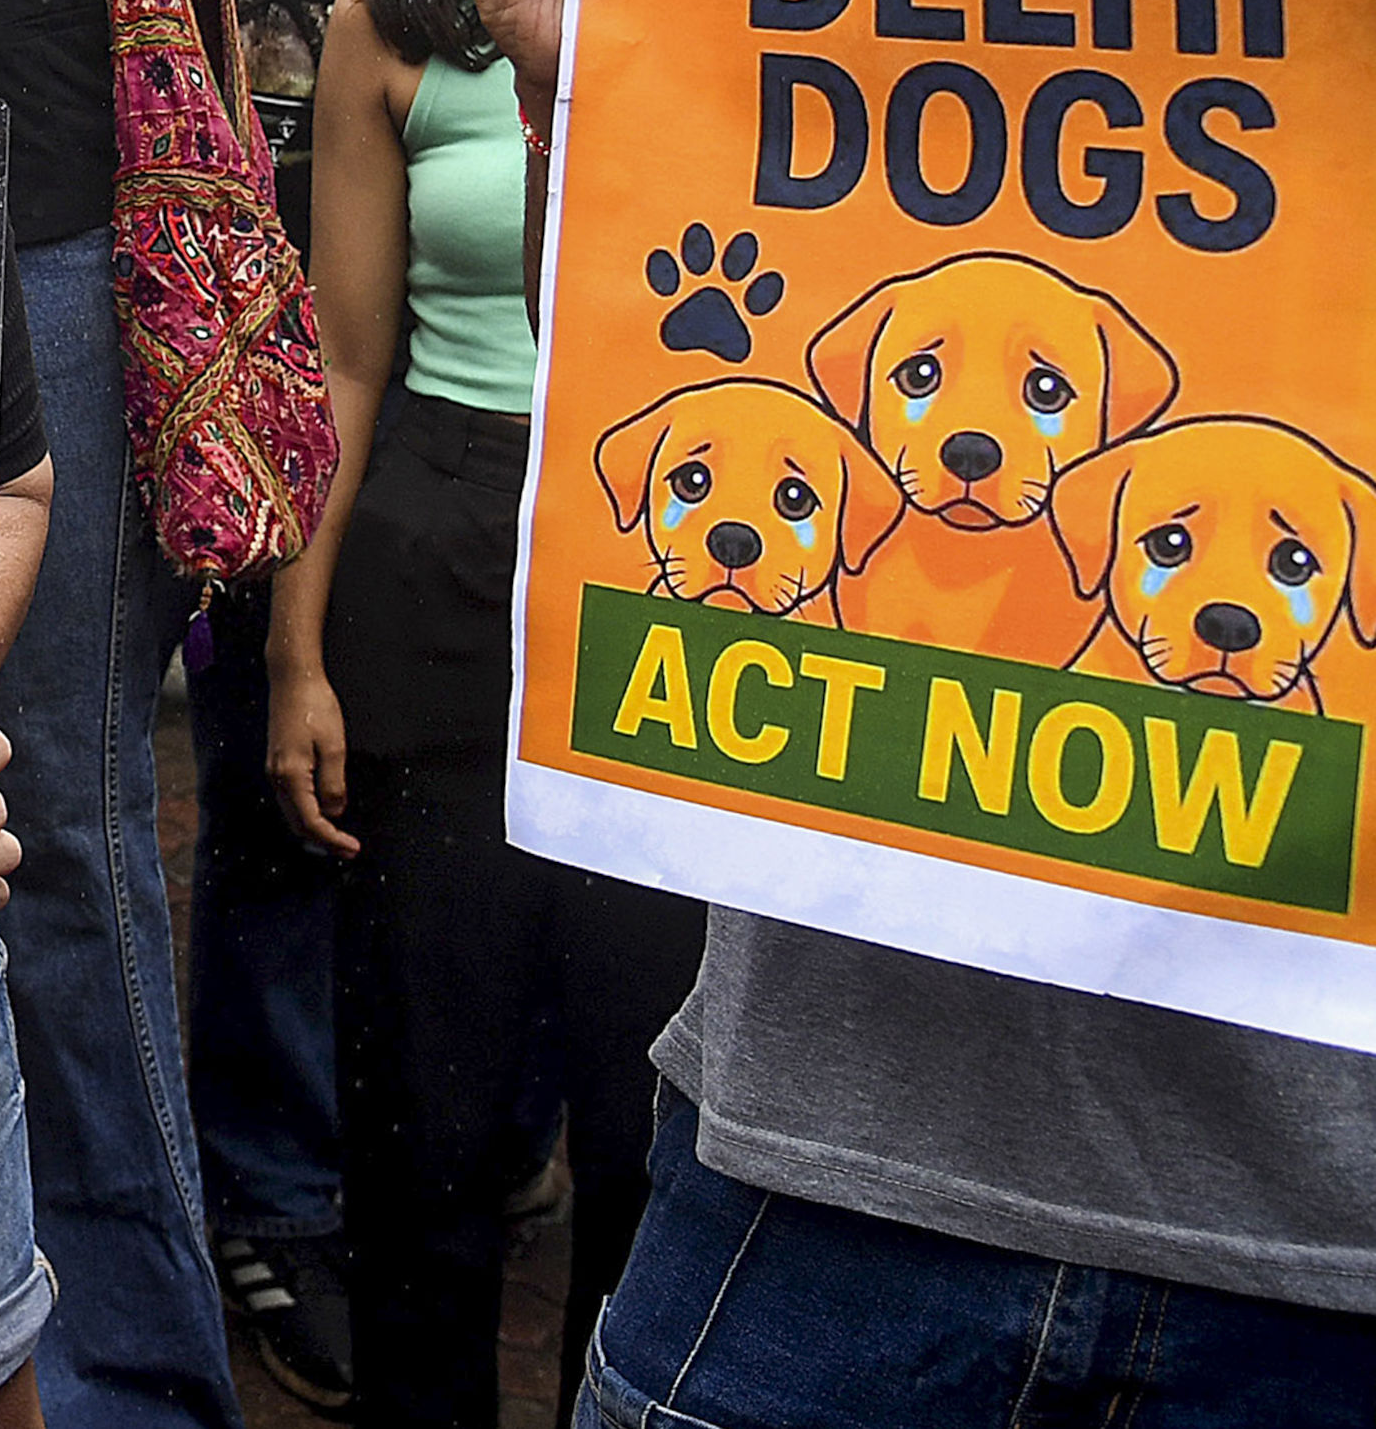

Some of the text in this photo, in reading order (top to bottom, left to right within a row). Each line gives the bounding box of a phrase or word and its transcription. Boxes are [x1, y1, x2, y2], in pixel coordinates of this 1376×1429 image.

[753, 52, 1276, 253] DOGS
[612, 624, 1302, 868] ACT NOW
